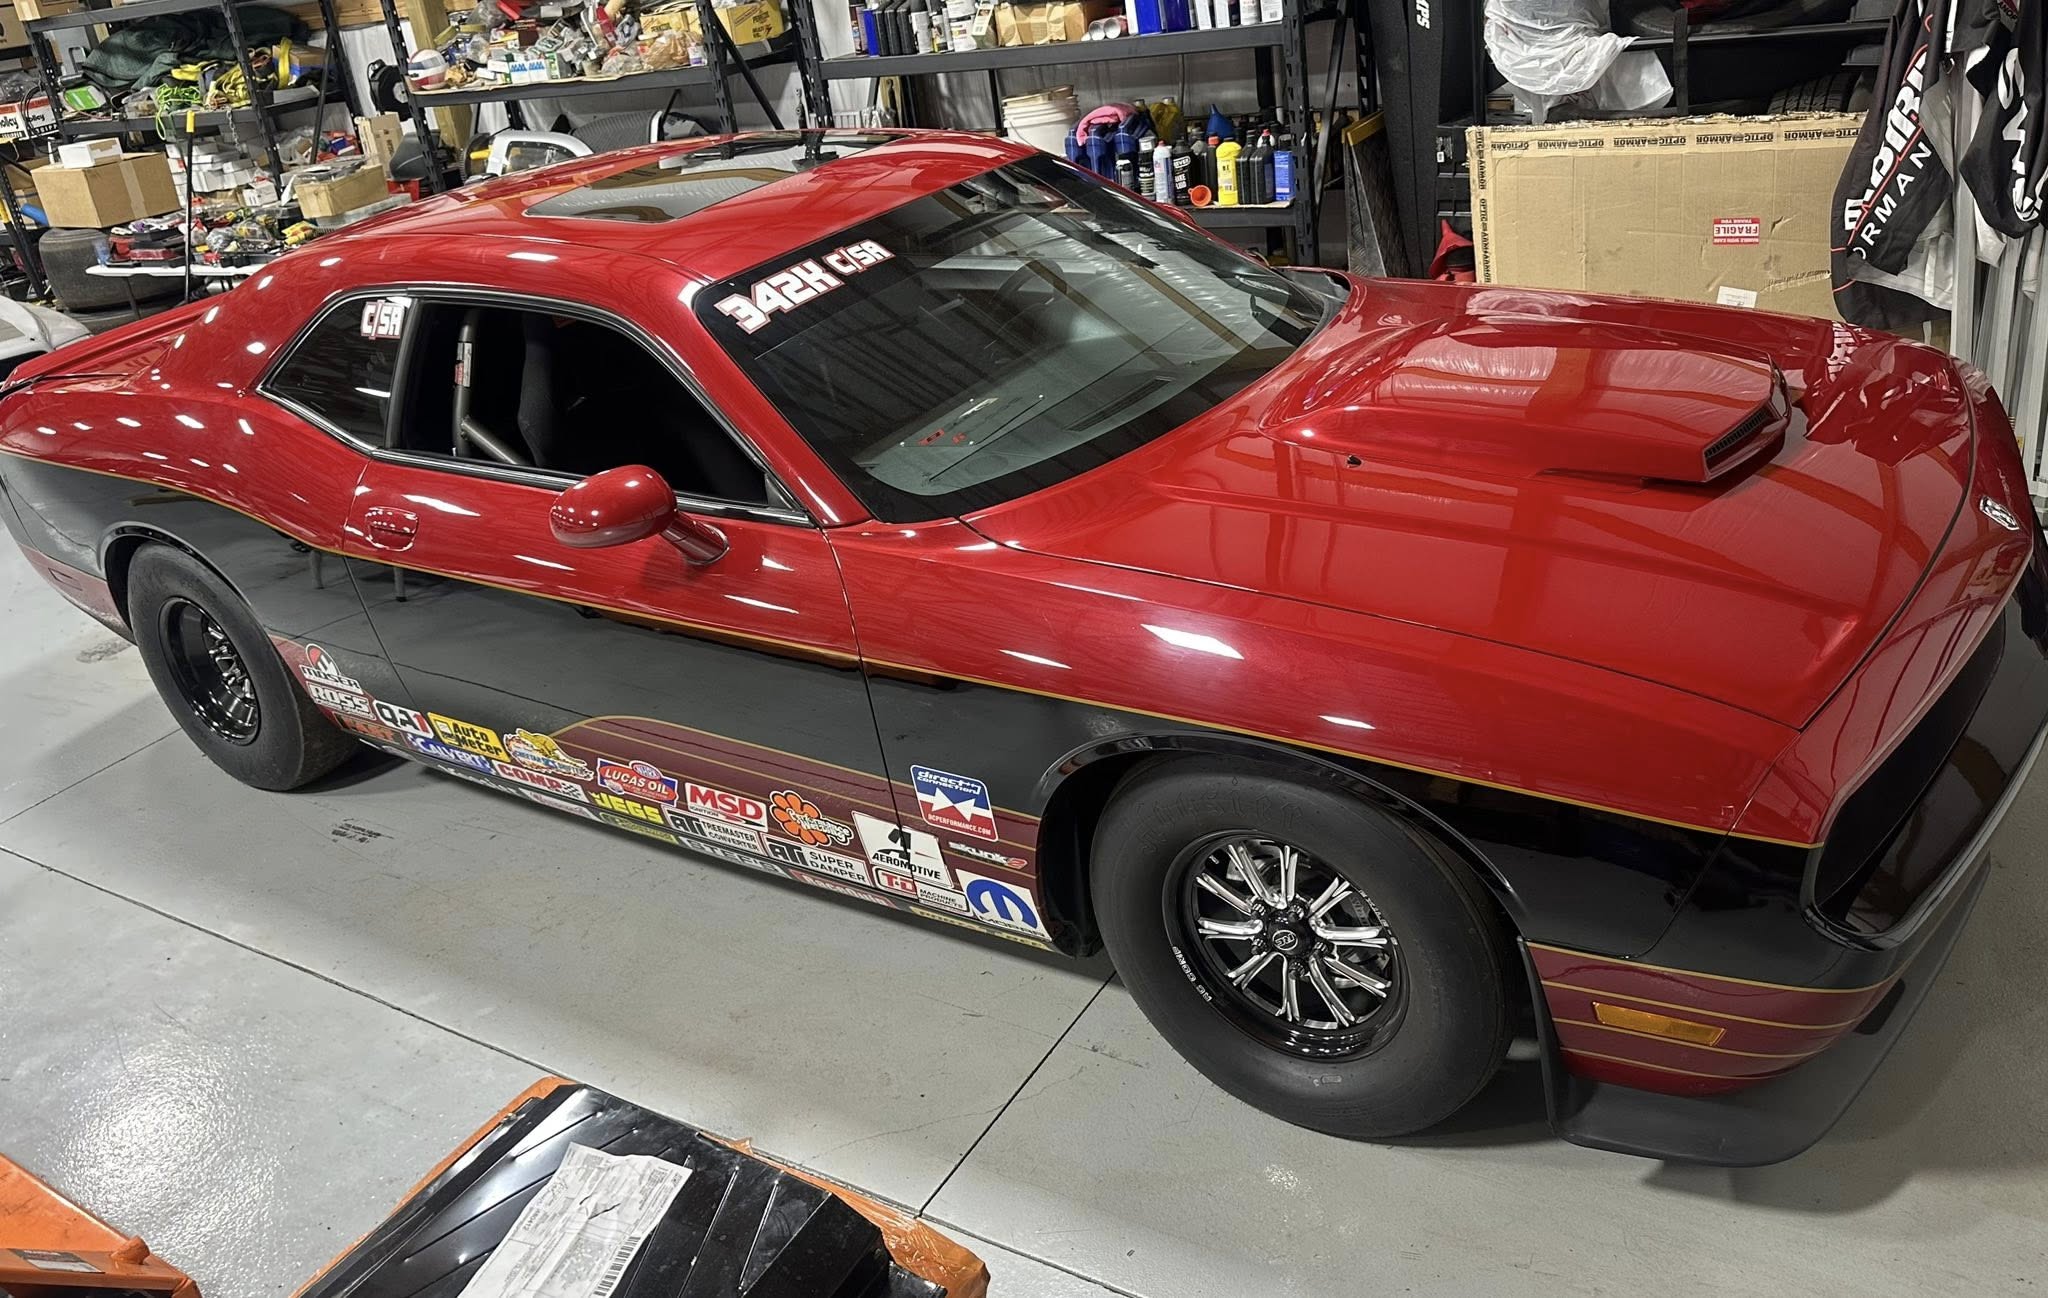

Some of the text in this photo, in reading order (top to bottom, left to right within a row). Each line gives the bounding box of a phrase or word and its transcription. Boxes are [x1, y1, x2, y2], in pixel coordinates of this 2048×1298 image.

[1579, 139, 1605, 148] OPTIC
[1613, 136, 1686, 148] OPTIC ARMOR
[1696, 133, 1774, 145] OPTIC ARMOR
[1784, 128, 1860, 141] PTIC ARMOR
[1715, 226, 1758, 235] FRAGILE
[715, 239, 895, 334] 342K C/SA
[361, 300, 404, 339] C/SA
[375, 702, 431, 734] QA1
[452, 723, 489, 743] Auto
[455, 735, 502, 756] Meter
[498, 764, 562, 789] COMP
[604, 768, 646, 787] LUCAS
[647, 781, 669, 795] OIL
[589, 791, 664, 825] JEGS
[689, 785, 763, 820] MSD
[702, 821, 757, 842] TREEMASTER
[927, 813, 992, 836] DCPERFORMANCE.COM
[708, 831, 760, 852] CONVERTER
[809, 851, 854, 871] SUPER
[809, 860, 866, 881] DAMPER
[872, 852, 941, 880] AEROMOTIVE
[881, 872, 917, 894] T&D
[919, 888, 957, 902] MACHINE
